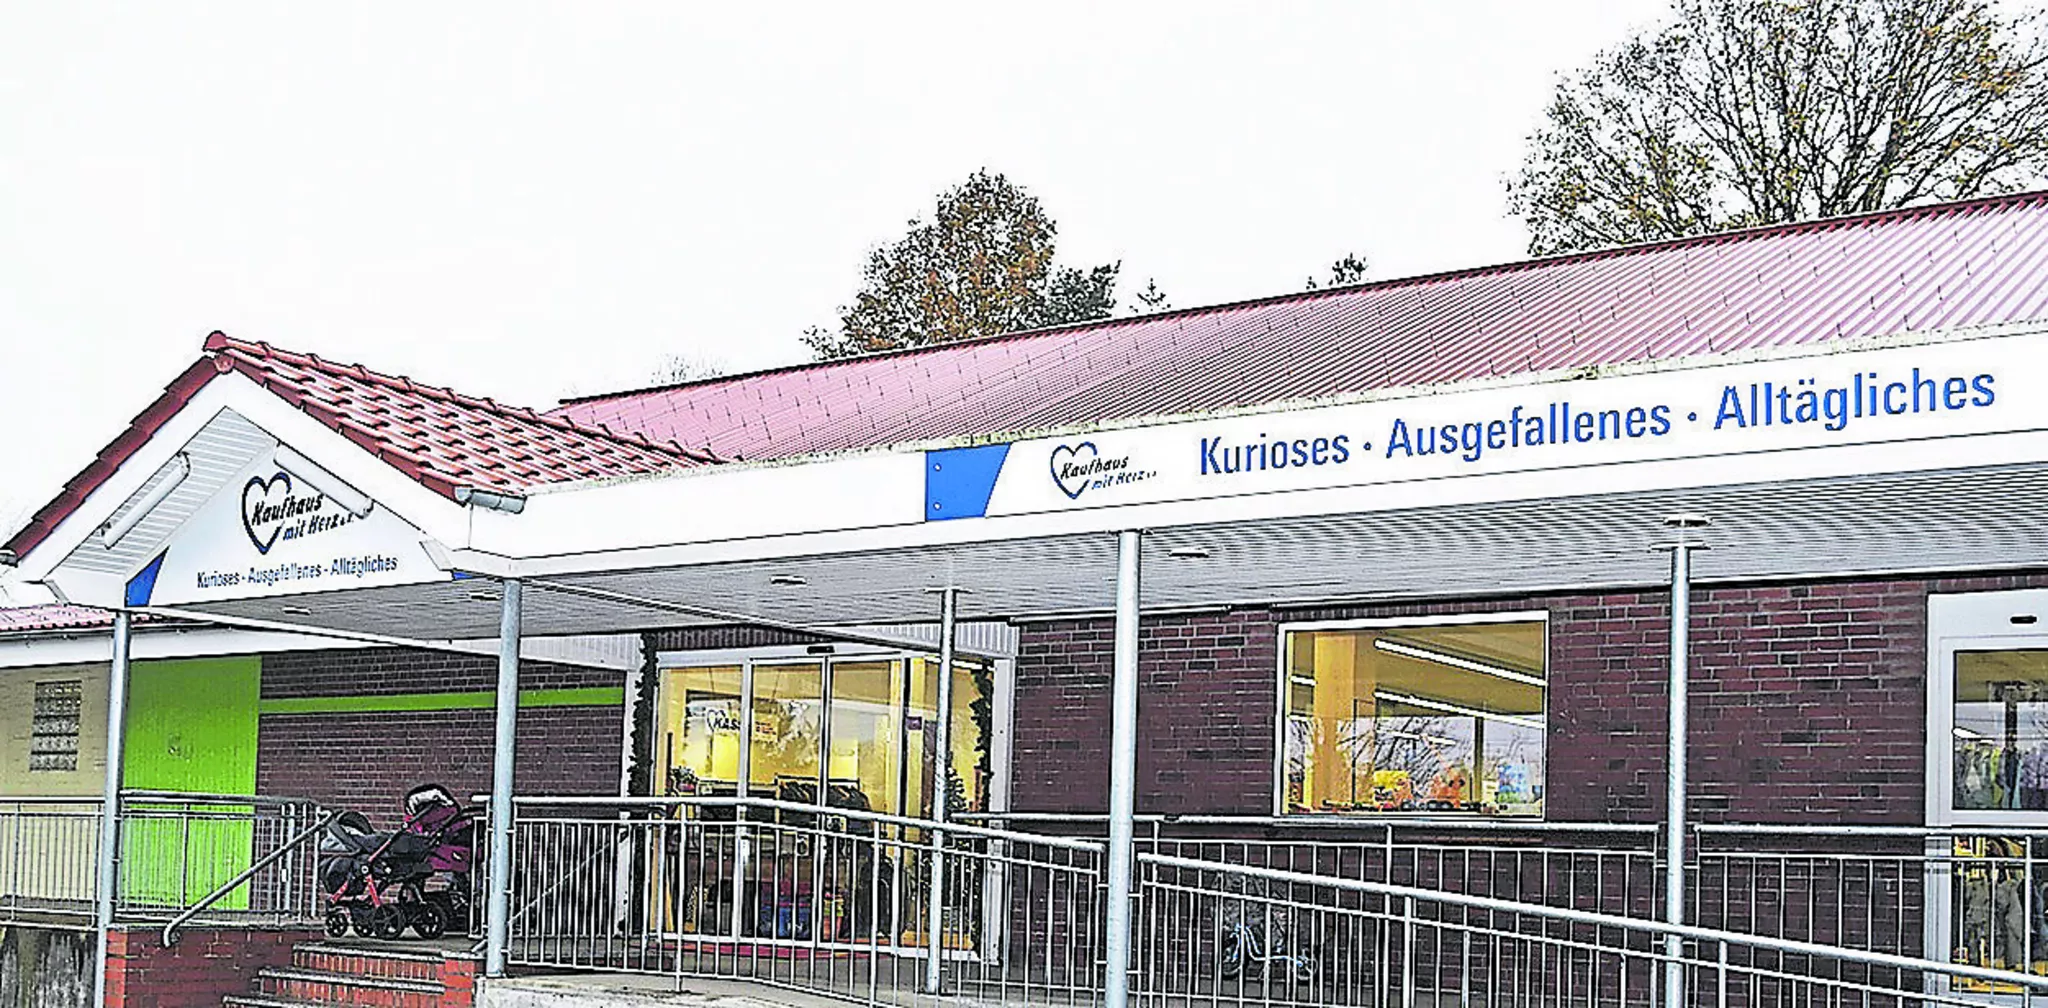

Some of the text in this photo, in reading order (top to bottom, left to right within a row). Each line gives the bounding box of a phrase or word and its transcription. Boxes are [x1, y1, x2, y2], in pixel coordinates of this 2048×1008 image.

[1200, 367, 1996, 475] Kurioses Ausgefallenes Alltägliches
[1060, 456, 1129, 480] Kaufhaus
[252, 493, 324, 526] Kaufhaus
[282, 518, 307, 541] mit
[307, 513, 340, 535] Herz
[197, 554, 399, 588] Kurioses Ausgefallenes Alltägliches
